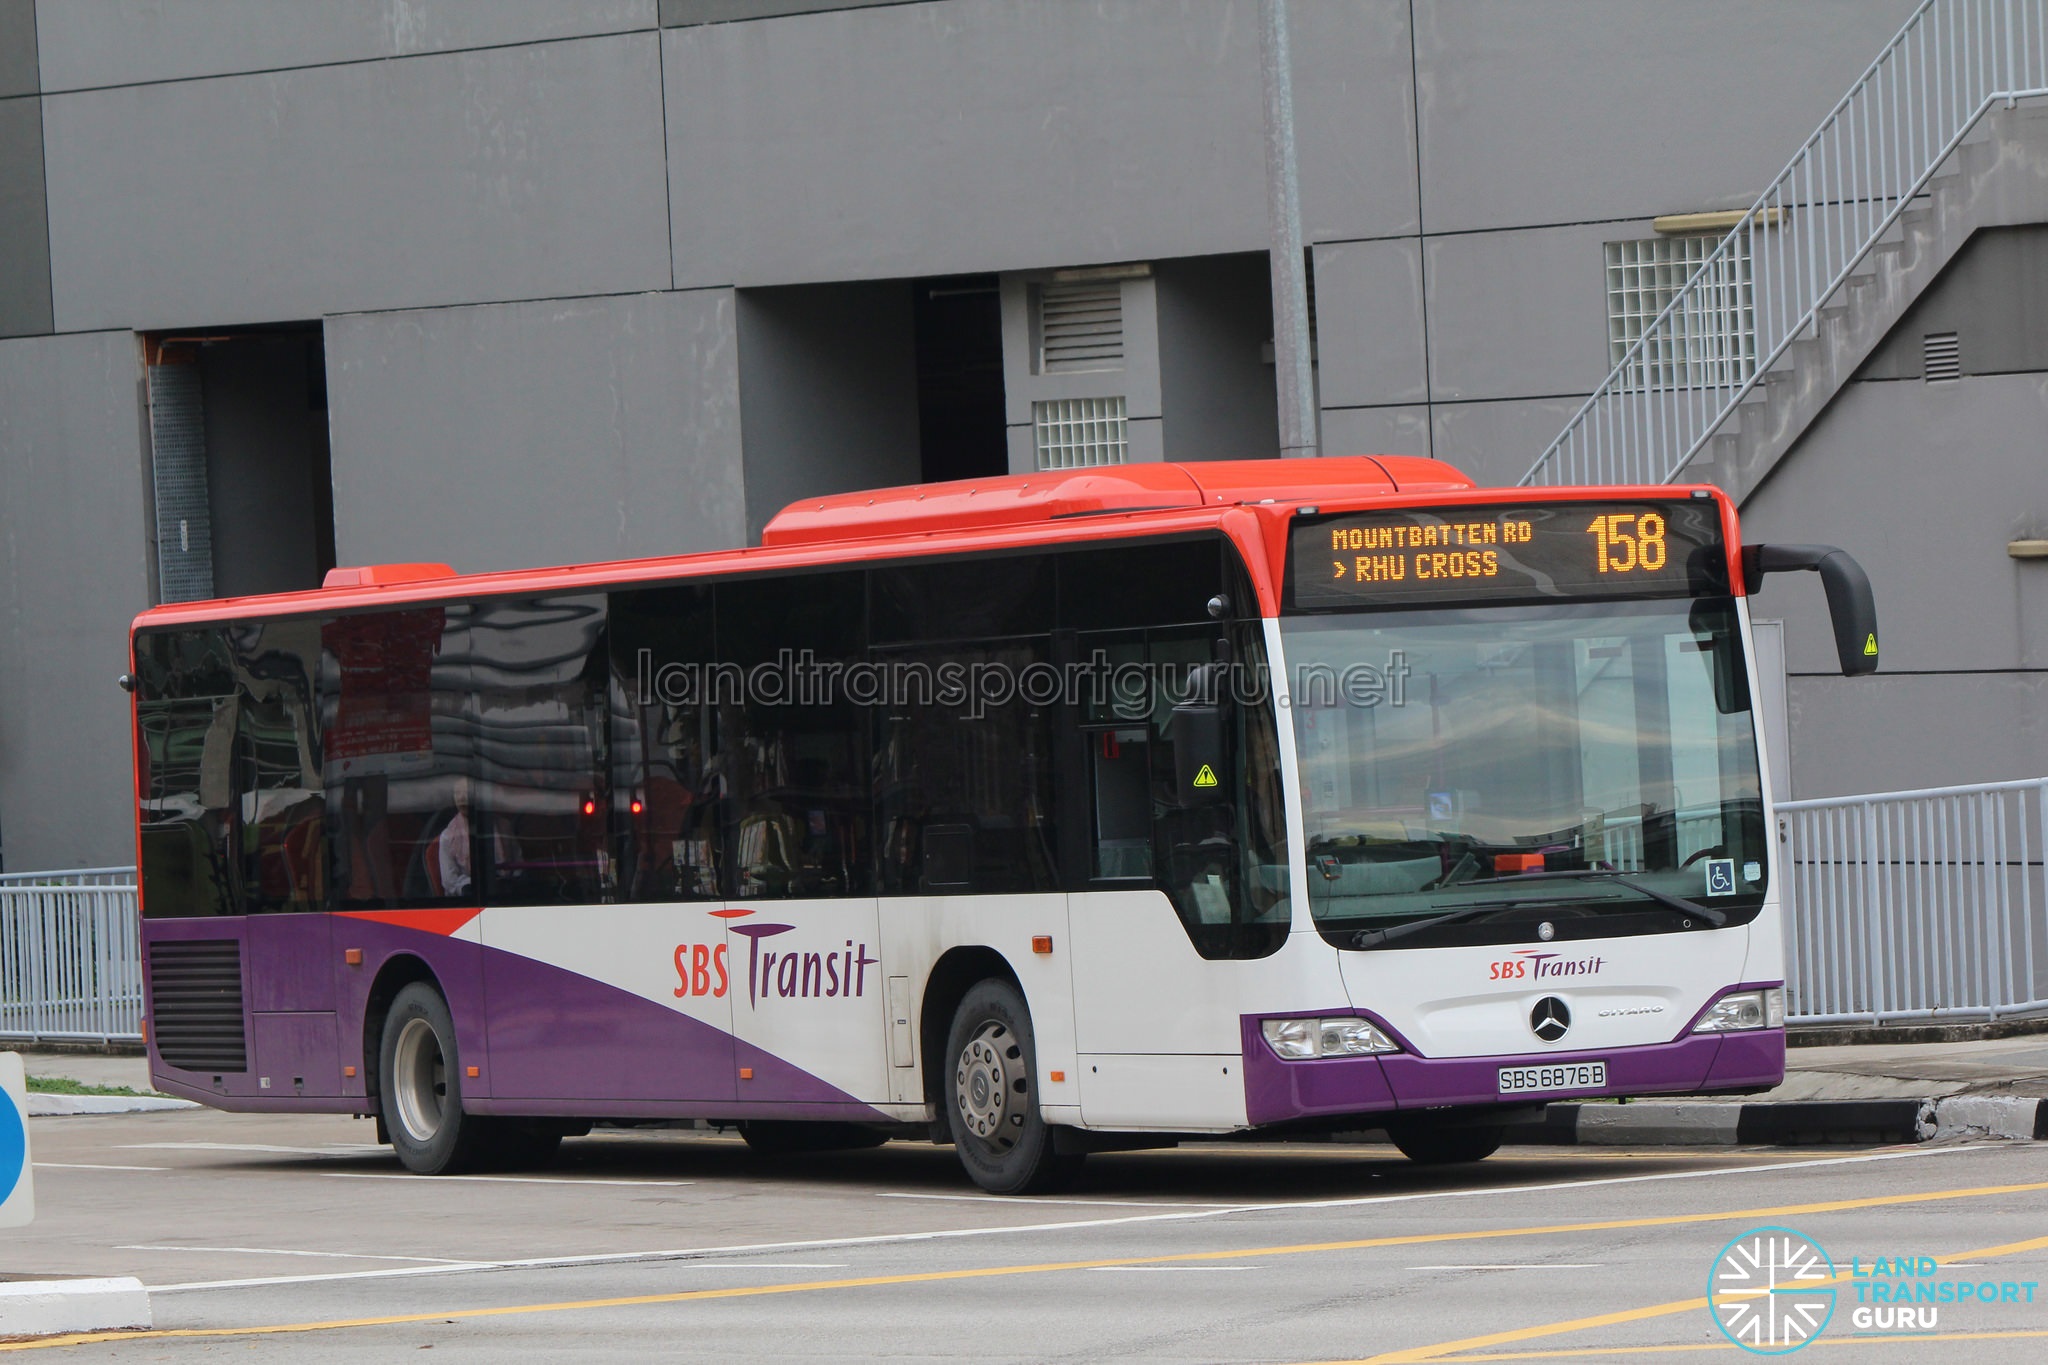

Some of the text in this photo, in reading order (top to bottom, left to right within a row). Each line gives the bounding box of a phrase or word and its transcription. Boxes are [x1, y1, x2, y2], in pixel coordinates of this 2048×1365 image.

[1332, 521, 1531, 551] MOUNTBATTEN RD
[1586, 513, 1666, 573] 158
[1356, 550, 1498, 582] RHU CROSS
[674, 923, 880, 1012] SBS Transit
[1489, 953, 1608, 981] SBS Transit
[1598, 1004, 1665, 1018] CITARO
[1500, 1064, 1604, 1090] SBS6876B
